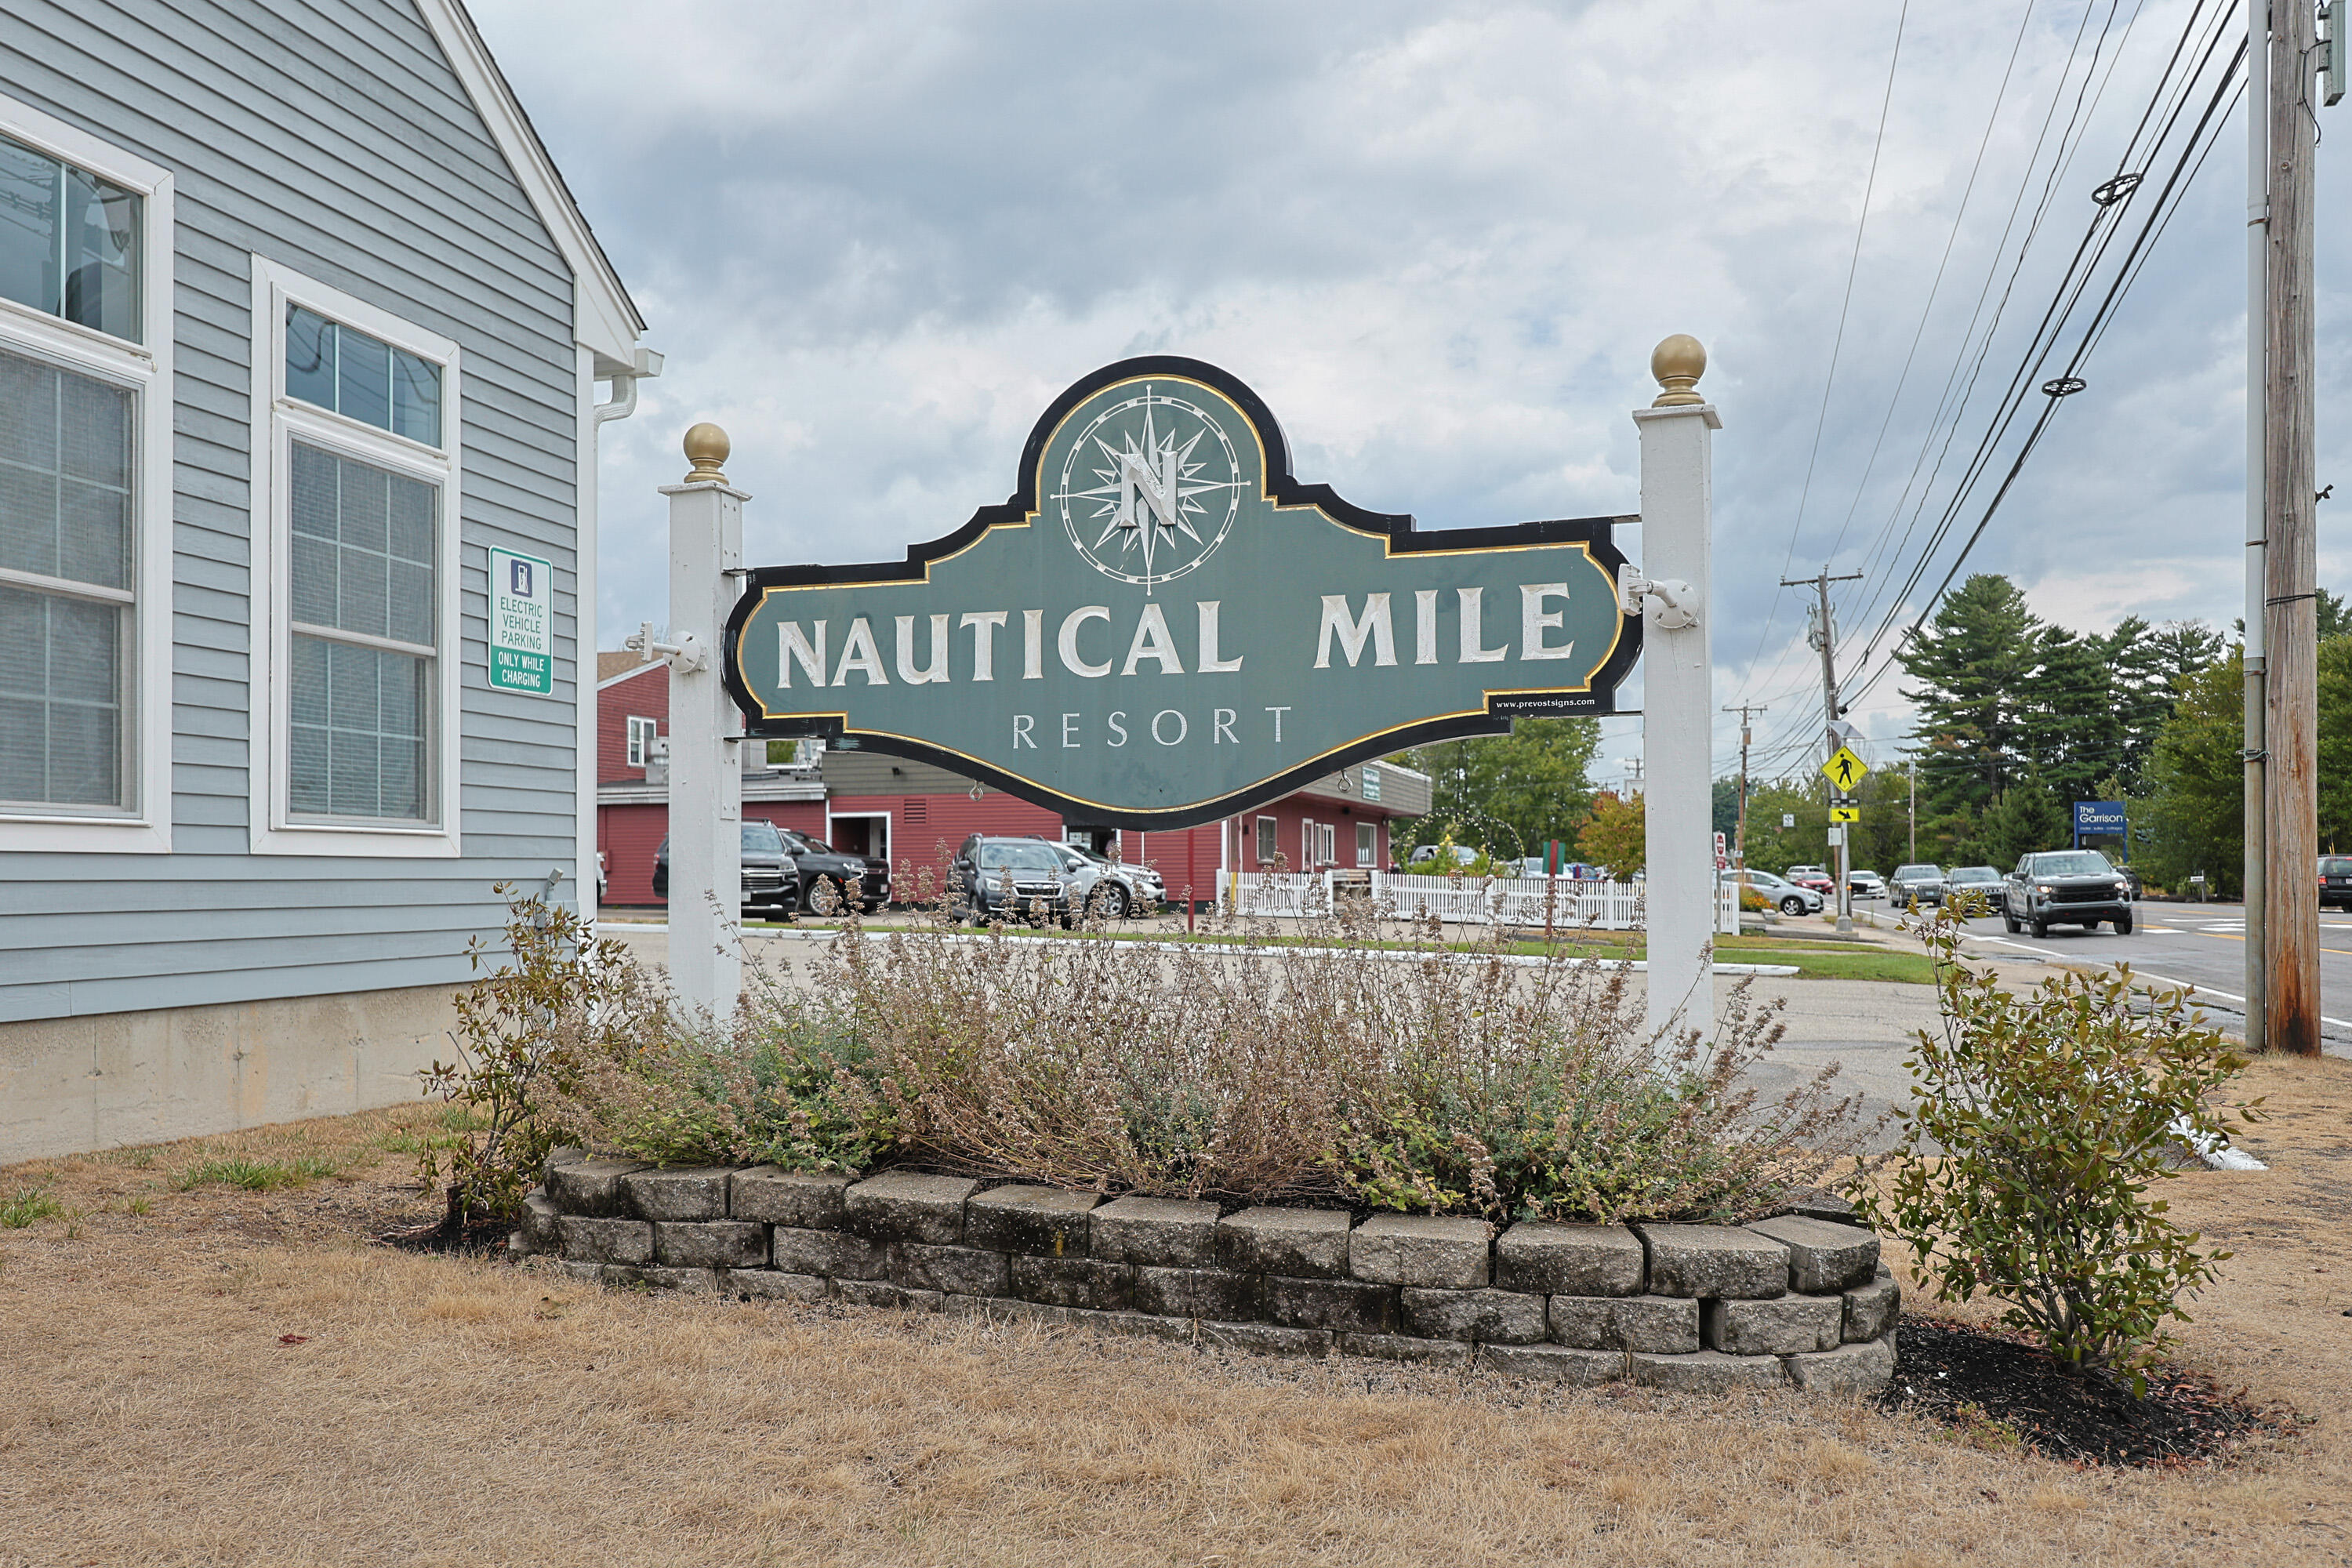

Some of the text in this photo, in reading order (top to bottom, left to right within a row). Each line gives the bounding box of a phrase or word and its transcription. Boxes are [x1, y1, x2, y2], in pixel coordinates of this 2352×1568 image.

[1114, 449, 1178, 528] N
[500, 597, 543, 618] ELECTRIC
[503, 614, 541, 633] VEHICLE
[502, 630, 542, 650] PARKING
[778, 583, 1575, 689] NAUTICAL MILE
[498, 652, 544, 672] ONLY WHILE
[502, 669, 541, 688] CHARGING
[1496, 699, 1595, 709] www.prevostsigns.com
[1012, 706, 1292, 750] RESORT
[2079, 813, 2123, 823] Garrison
